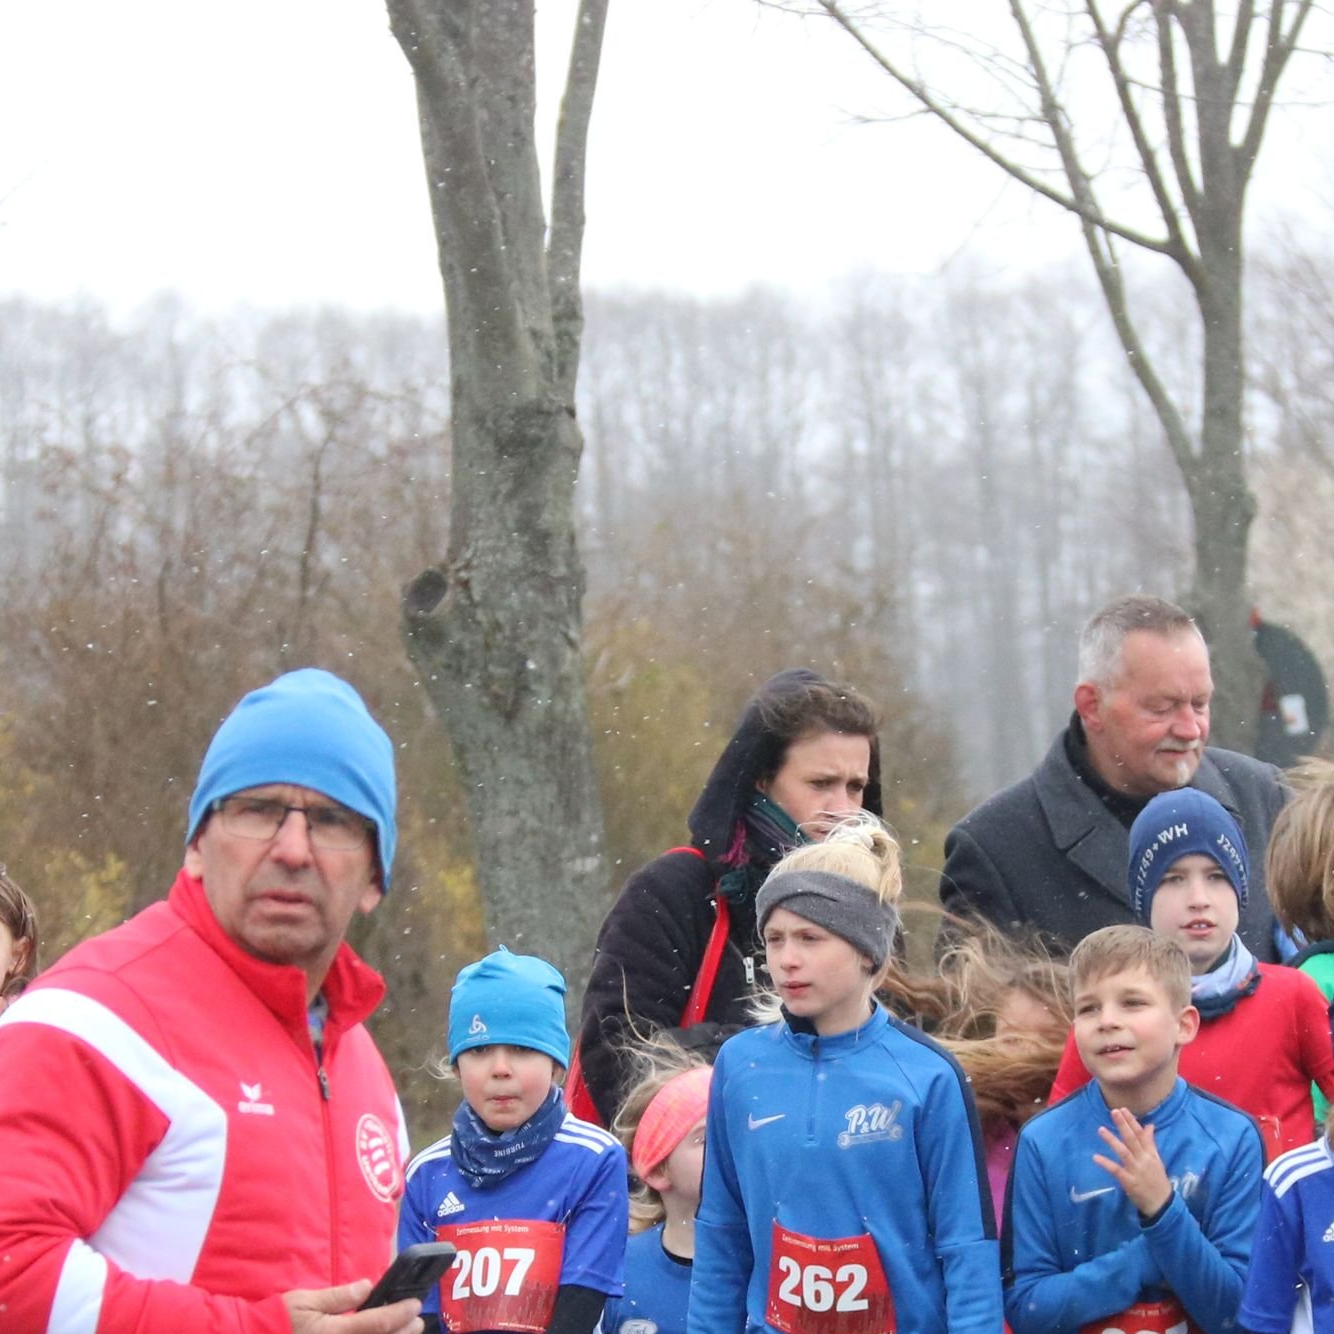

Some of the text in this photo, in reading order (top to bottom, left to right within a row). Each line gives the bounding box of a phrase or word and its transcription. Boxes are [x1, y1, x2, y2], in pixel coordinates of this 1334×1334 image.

[437, 1203, 465, 1217] adidas
[456, 1226, 489, 1236] Zeitmessung
[503, 1224, 529, 1233] System
[782, 1233, 816, 1252] Zeitmessung
[833, 1243, 859, 1253] System
[451, 1247, 536, 1301] 207
[779, 1255, 869, 1312] 262
